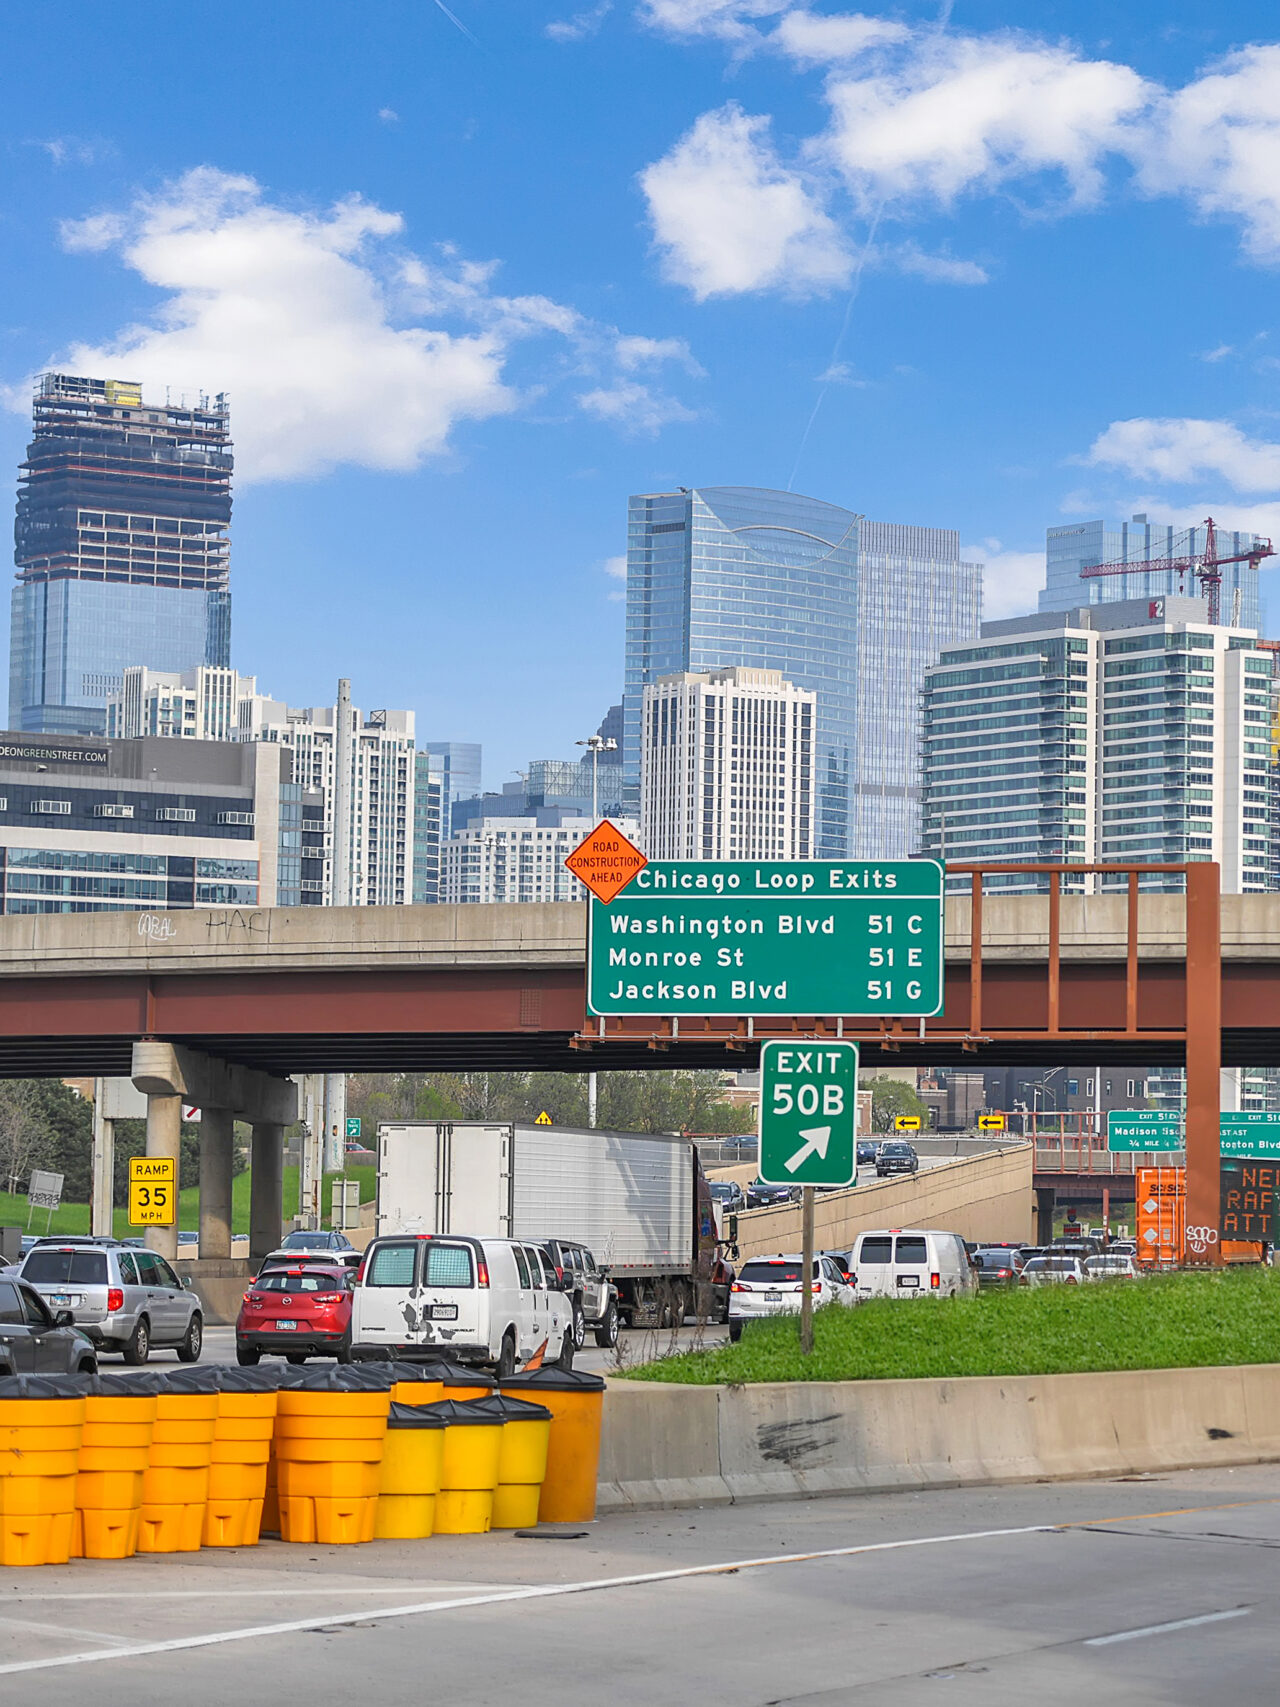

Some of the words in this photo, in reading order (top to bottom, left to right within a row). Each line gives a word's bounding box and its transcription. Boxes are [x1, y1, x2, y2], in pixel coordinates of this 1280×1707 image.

[592, 841, 619, 852] ROAD
[570, 855, 640, 868] CONSTRUCTION
[590, 872, 623, 883] AHEAD
[636, 869, 740, 896] Chicago
[755, 869, 815, 892] Loop
[829, 869, 897, 889] Exits
[610, 914, 764, 940] Washington
[778, 915, 834, 934] Blvd
[868, 915, 893, 934] 51
[907, 914, 923, 934] C
[609, 947, 702, 967] Monroe
[717, 947, 744, 967] St
[869, 947, 894, 967] 51
[908, 948, 922, 967] E
[609, 980, 716, 999] Jackson
[731, 980, 787, 1000] Blvd
[867, 980, 892, 1000] 51
[906, 980, 922, 1000] G
[777, 1051, 842, 1074] EXIT
[772, 1083, 844, 1117] 50B
[1114, 1127, 1158, 1136] Madison
[136, 1164, 169, 1175] RAMP
[138, 1187, 167, 1207] 35
[140, 1212, 163, 1220] MPH
